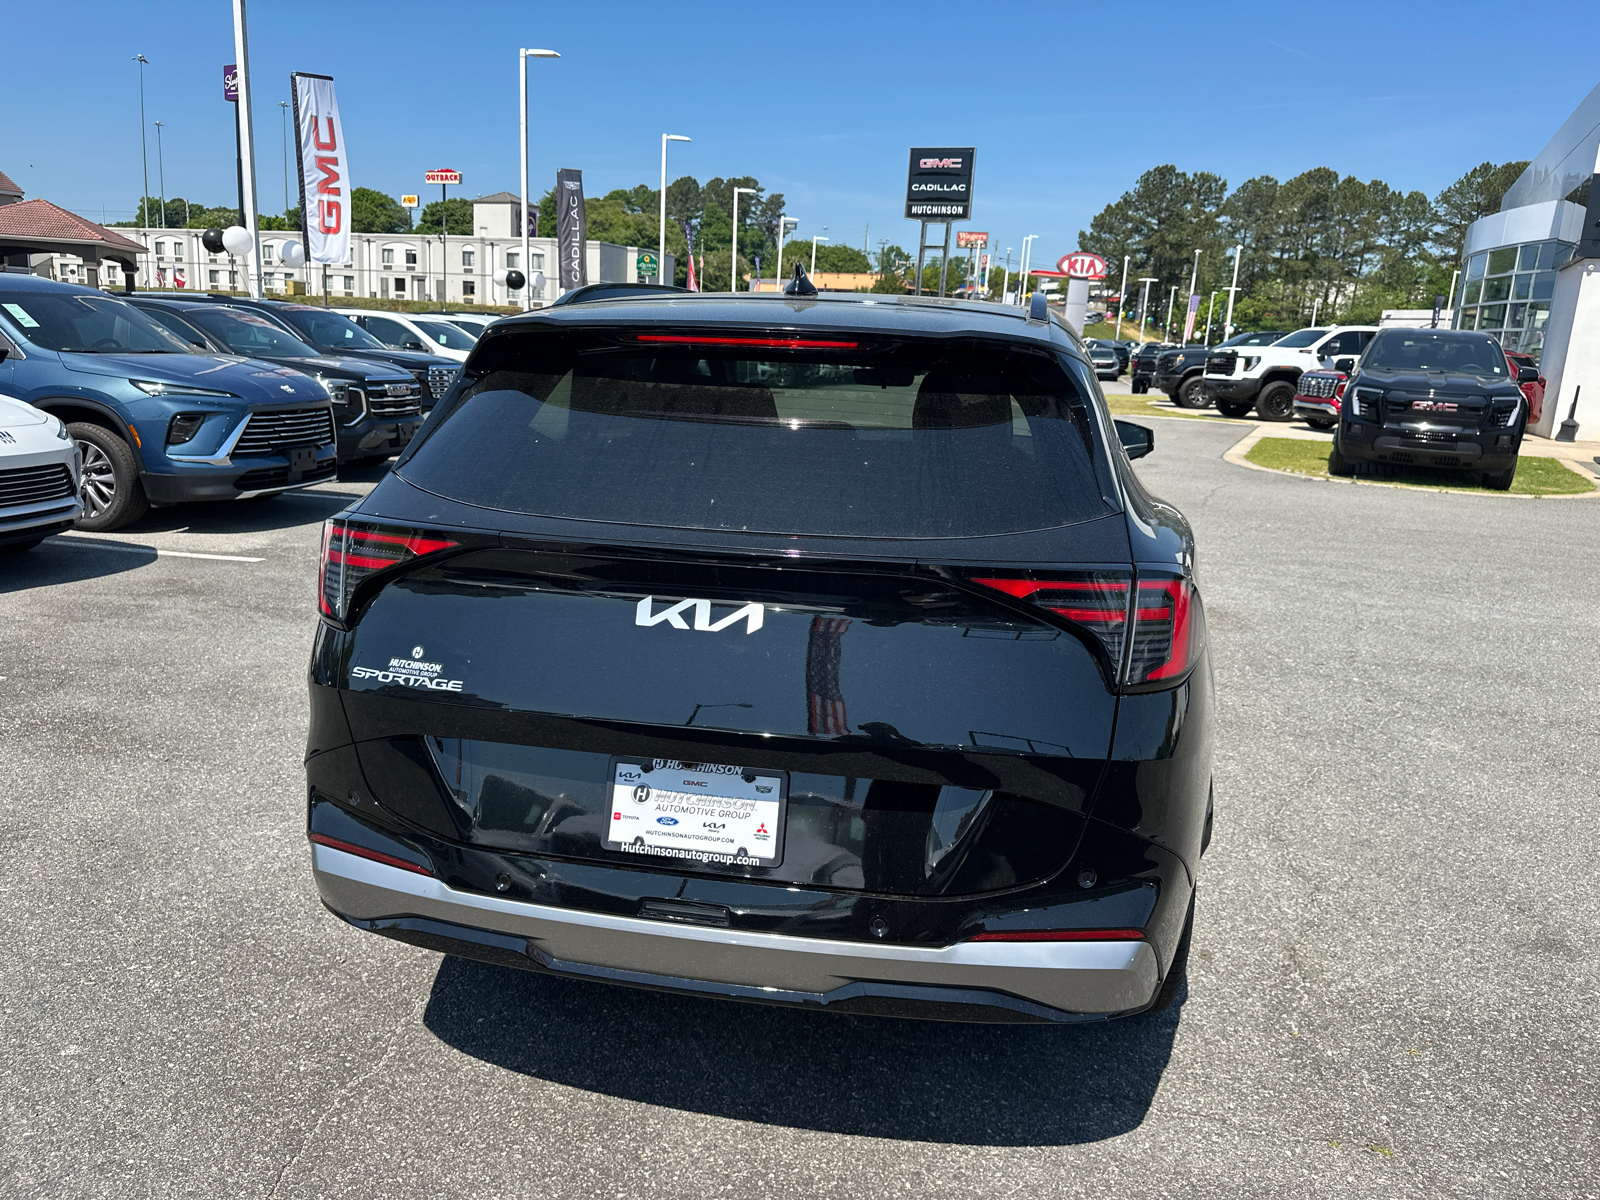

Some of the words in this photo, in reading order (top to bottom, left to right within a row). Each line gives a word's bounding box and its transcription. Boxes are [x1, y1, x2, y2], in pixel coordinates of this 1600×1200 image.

[920, 158, 962, 168] GMC
[311, 115, 342, 235] GMC
[911, 205, 963, 214] HUTCHINSON
[569, 195, 580, 282] CADILLAC
[1067, 257, 1097, 274] KIA
[1412, 401, 1458, 412] GMC
[635, 595, 764, 635] KIA
[388, 667, 420, 676] AUTOMOTIVE
[389, 659, 442, 672] HUTCHINSON
[352, 666, 463, 691] SPORTAGE
[619, 771, 641, 779] KIA
[654, 788, 757, 812] HUTCHINSON
[655, 803, 716, 817] AUTOMOTIVE
[718, 809, 751, 820] GROUP
[660, 817, 675, 825] Ford
[645, 830, 735, 843] HUTCHINSONAUTOGROUP.COM
[621, 842, 760, 866] Hutchinsonautogroup.com
